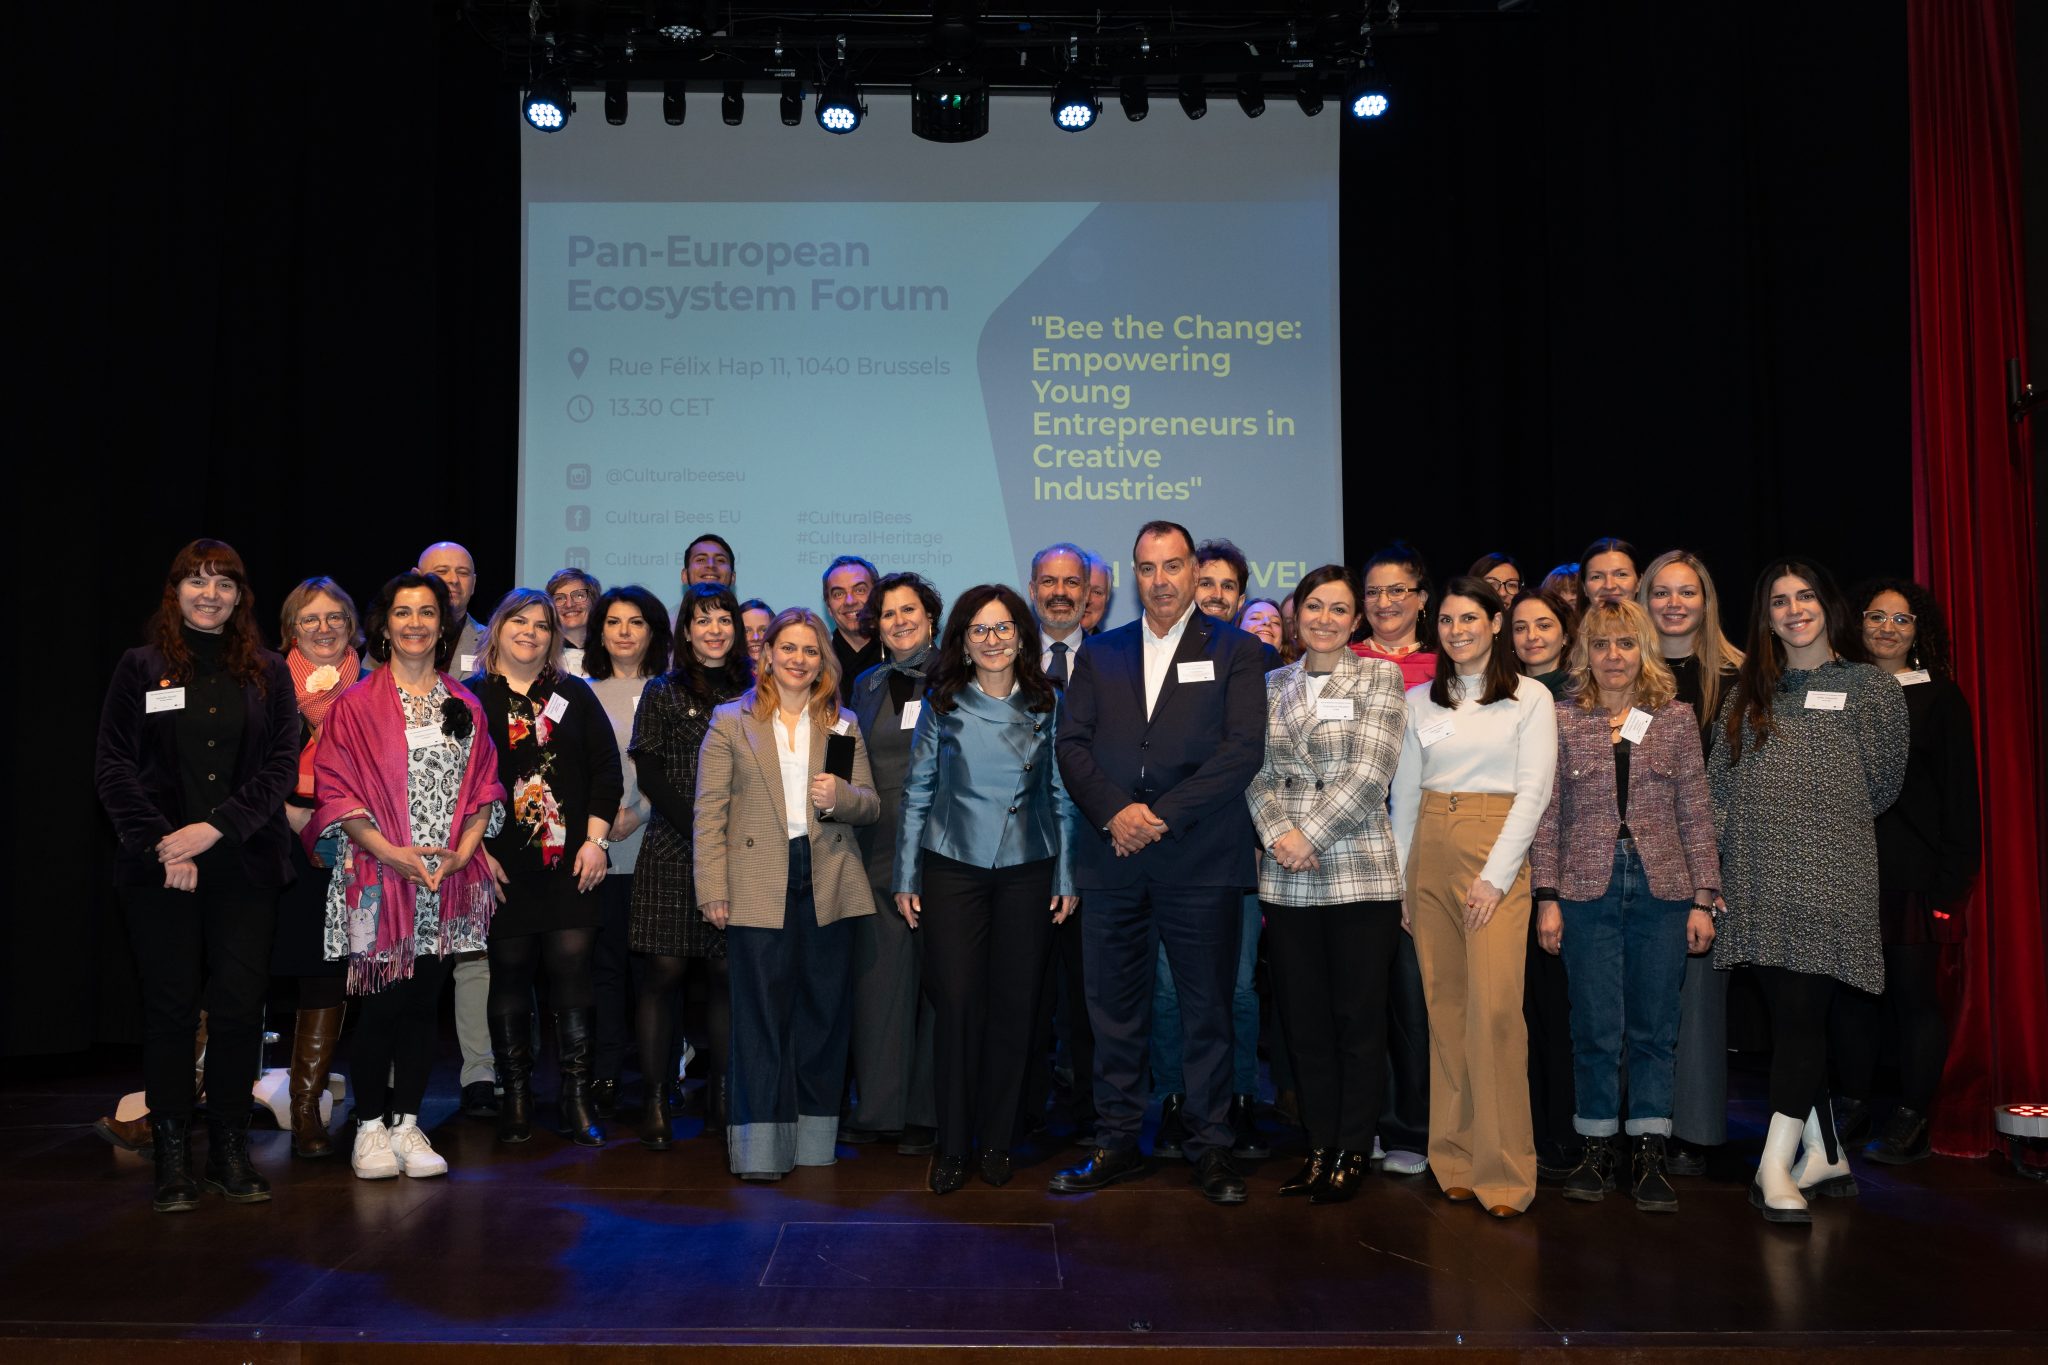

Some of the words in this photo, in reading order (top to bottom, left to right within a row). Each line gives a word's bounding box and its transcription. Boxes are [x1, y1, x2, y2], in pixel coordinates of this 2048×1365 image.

[568, 235, 870, 275] Pan-European
[568, 279, 796, 319] Ecosystem
[811, 279, 949, 311] Forum
[1031, 315, 1104, 340] "Bee
[1112, 315, 1164, 340] the
[1173, 315, 1303, 345] Change:
[609, 358, 654, 376] Rue
[660, 356, 711, 376] Félix
[718, 358, 764, 381] Hap
[770, 358, 791, 379] 11,
[798, 357, 850, 376] 1040
[857, 356, 951, 376] Brussels
[1032, 346, 1231, 378] Empowering
[609, 398, 664, 417] 13.30
[670, 398, 714, 417] CET
[1031, 380, 1131, 410] Young
[1033, 411, 1258, 442] Entrepreneurs
[1267, 409, 1295, 436] in
[1033, 442, 1162, 468] Creative
[606, 468, 746, 486] @Culturalbeeseu
[1034, 474, 1202, 501] Industries"
[605, 510, 669, 524] Cultural
[674, 510, 714, 524] Bees
[719, 510, 742, 524] EU
[797, 510, 912, 525] #CulturalBees
[796, 530, 943, 547] #CulturalHeritage
[605, 552, 669, 566] Cultural
[797, 550, 953, 567] #Entreneurship
